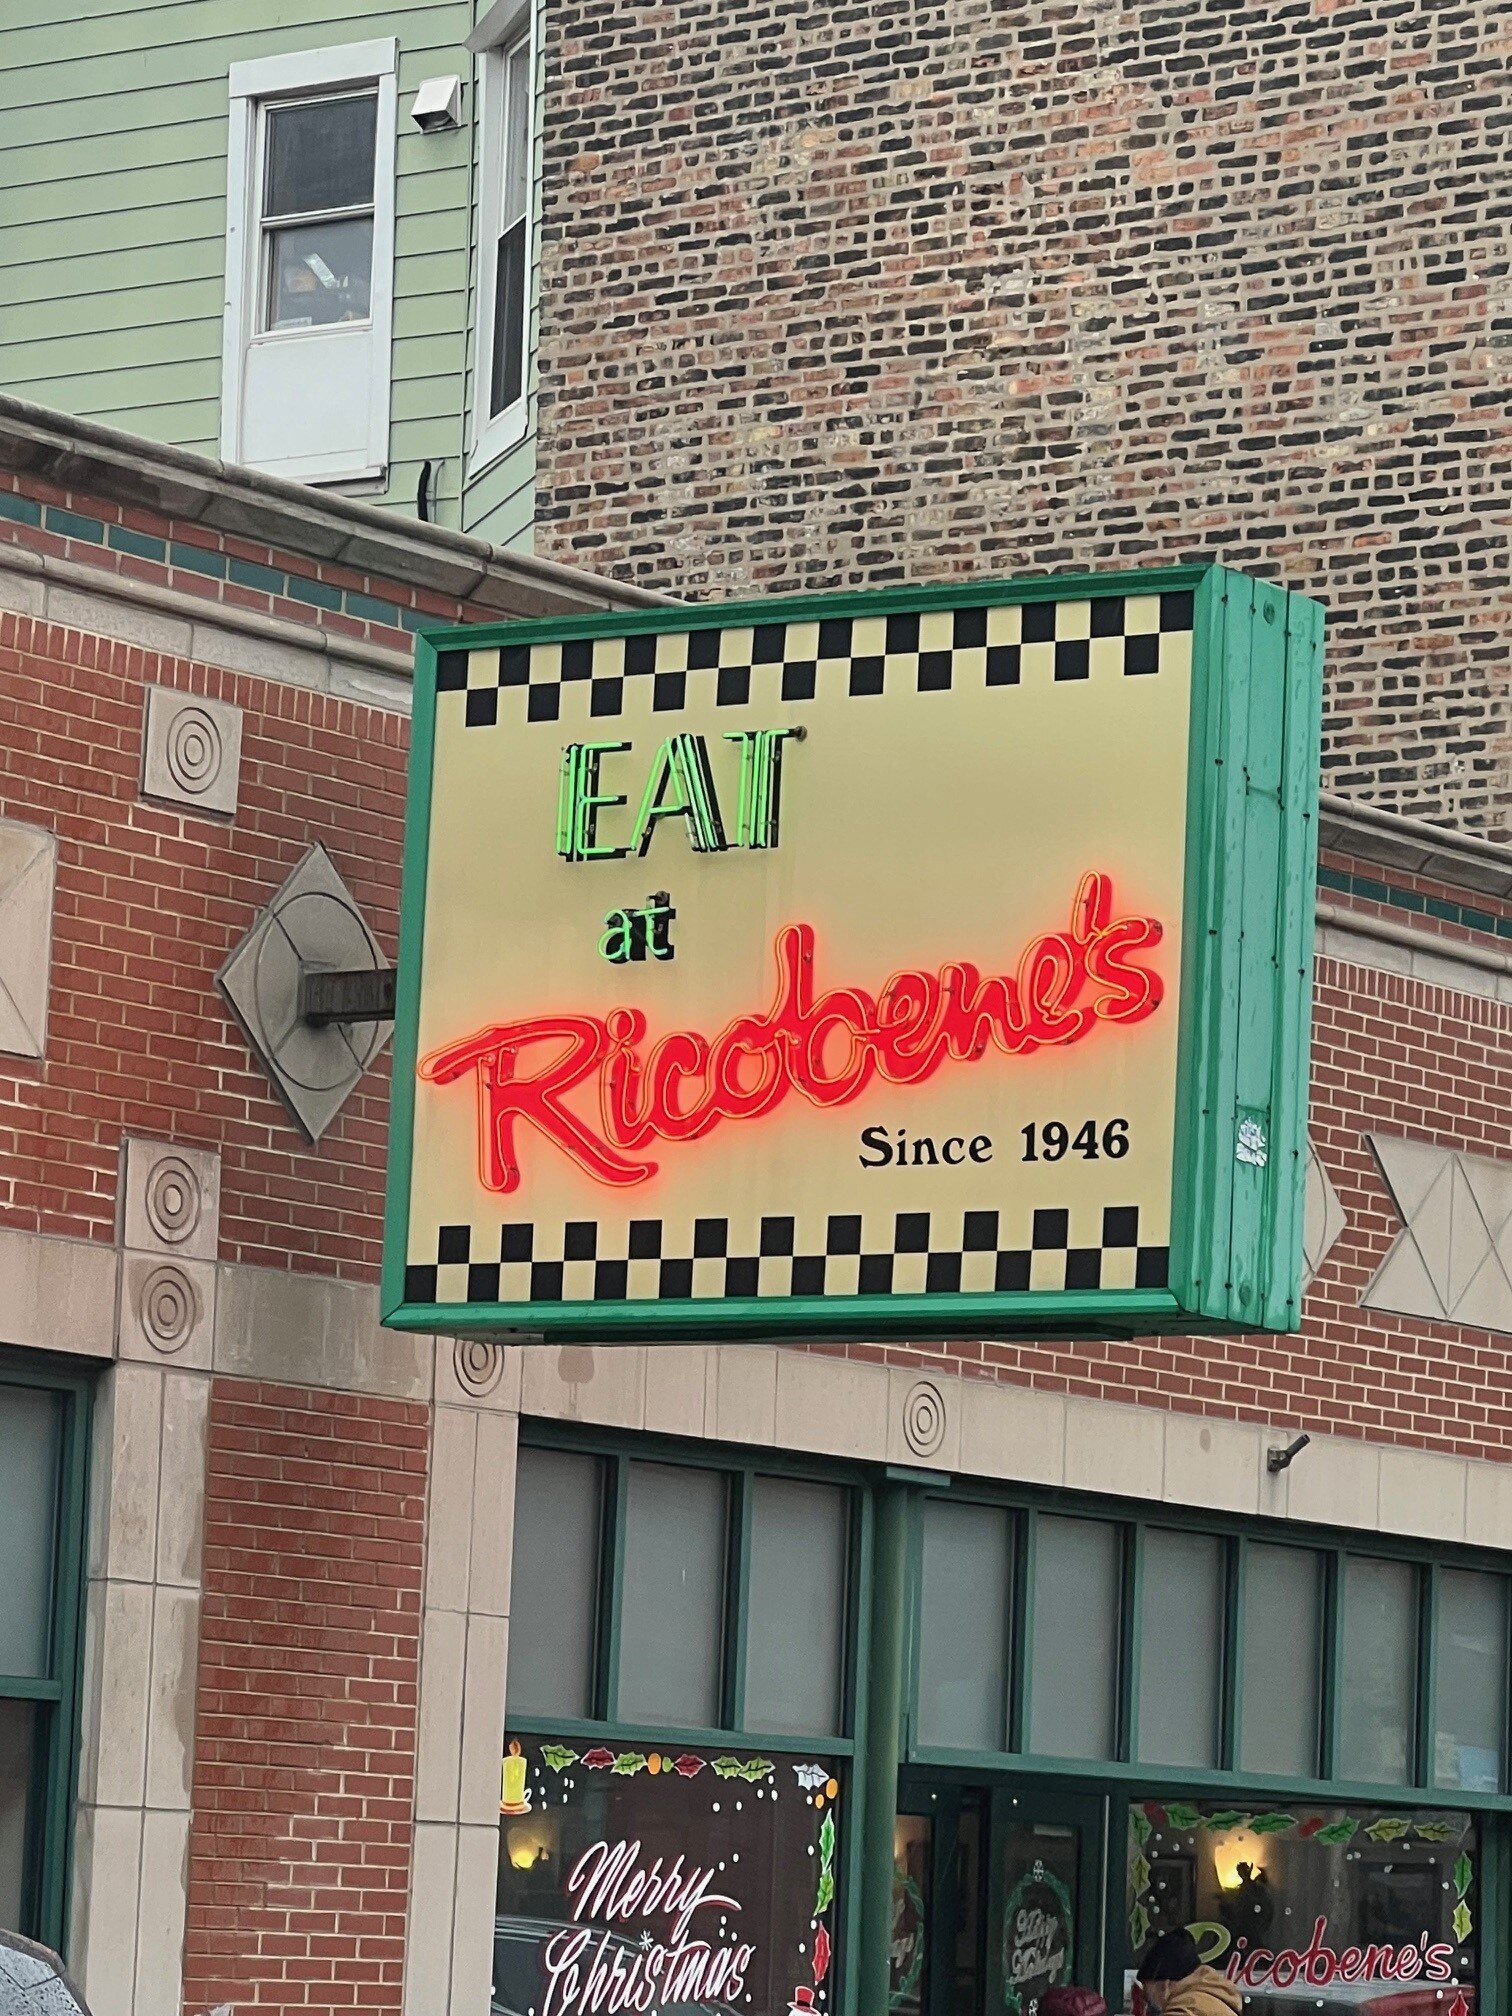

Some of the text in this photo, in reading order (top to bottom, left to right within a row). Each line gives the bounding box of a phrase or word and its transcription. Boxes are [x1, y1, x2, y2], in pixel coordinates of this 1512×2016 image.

[557, 727, 808, 862] EAT
[597, 890, 676, 964] at
[418, 870, 1163, 1193] Ricobene's
[859, 1118, 1130, 1169] Since 1946
[567, 1839, 742, 1944] Merry
[543, 1929, 756, 2016] Christmas
